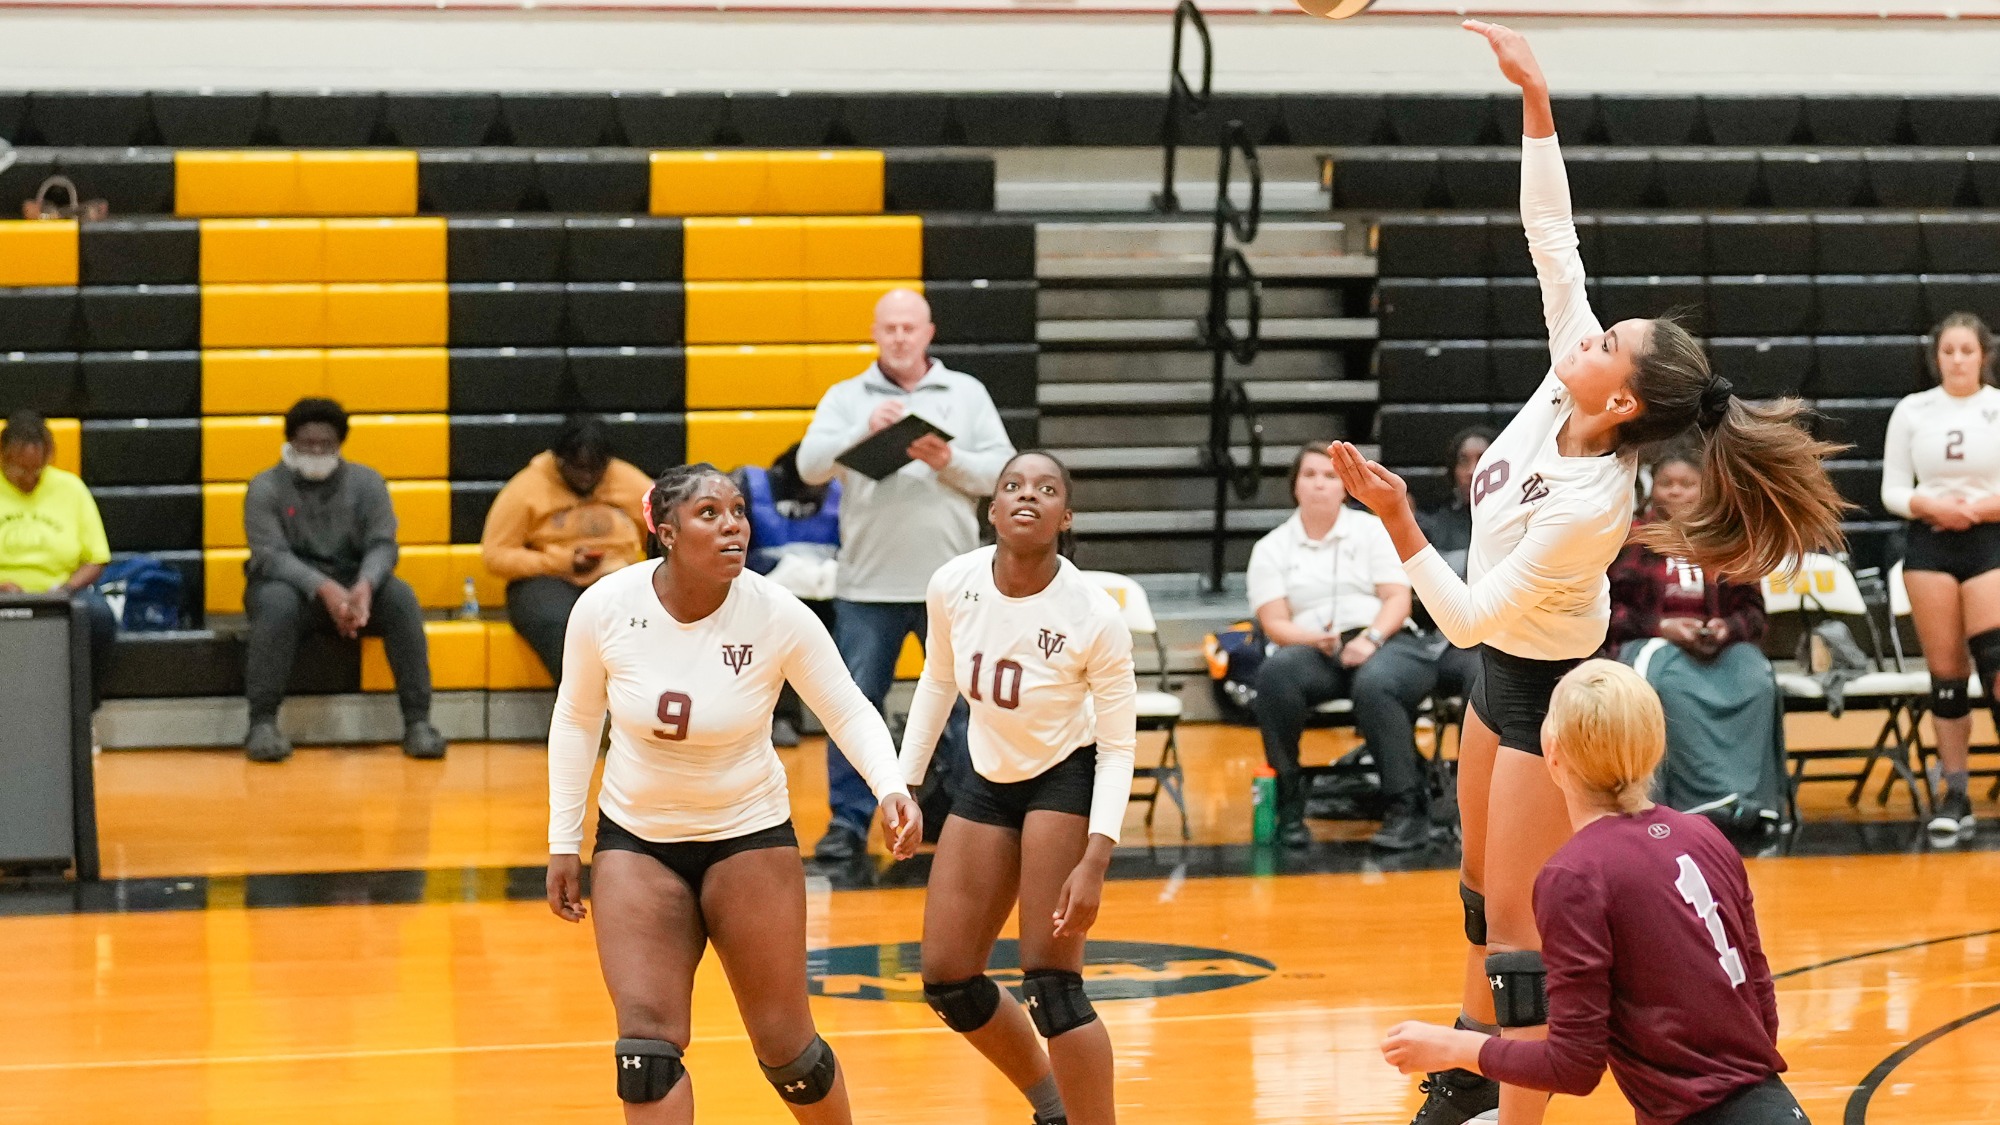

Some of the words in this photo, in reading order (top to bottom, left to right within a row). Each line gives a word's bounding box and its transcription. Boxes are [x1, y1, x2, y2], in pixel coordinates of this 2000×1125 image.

[1945, 429, 1965, 460] 2
[1474, 459, 1510, 507] 8
[969, 652, 1023, 710] 10
[652, 690, 693, 742] 9
[1674, 853, 1747, 989] 1
